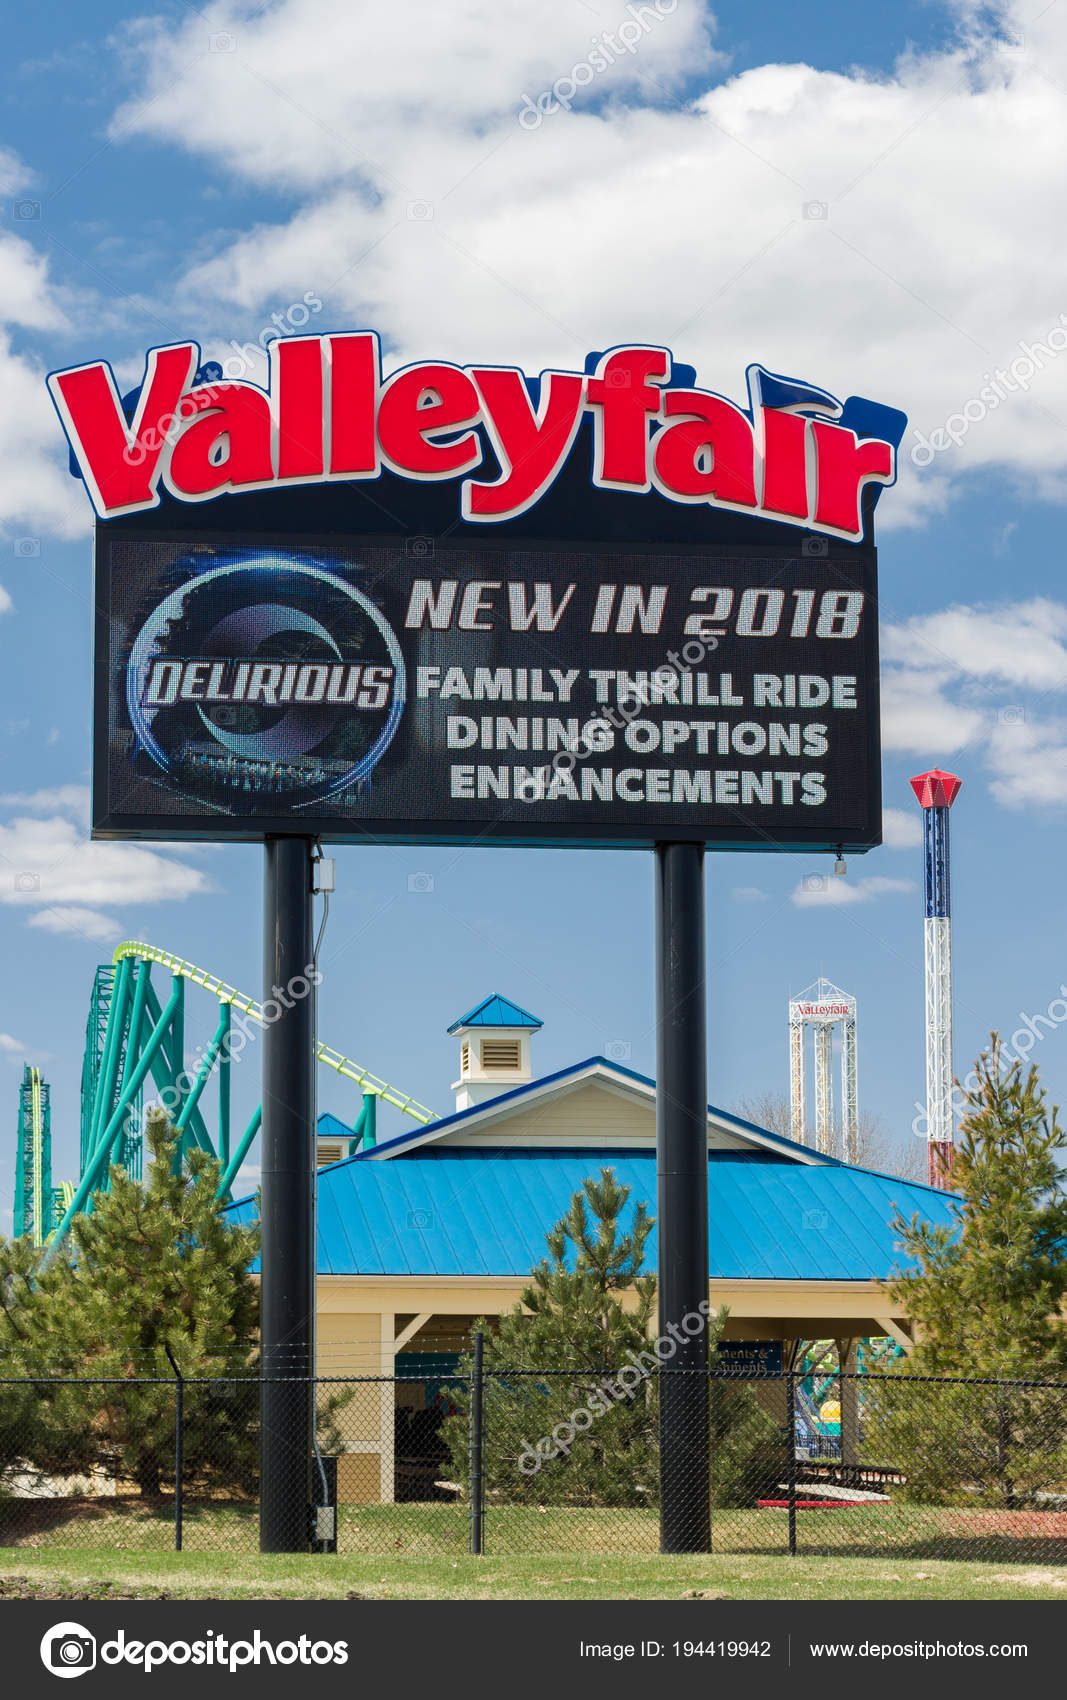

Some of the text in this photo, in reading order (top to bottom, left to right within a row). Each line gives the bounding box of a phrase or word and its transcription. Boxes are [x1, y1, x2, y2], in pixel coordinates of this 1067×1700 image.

[48, 331, 897, 542] Valleyfair
[404, 579, 865, 639] NEW IN 2018
[147, 661, 393, 709] DELIRIOUS
[416, 666, 858, 709] FAMILY THRILL RIDE
[446, 716, 829, 757] DINING OPTIONS
[450, 765, 827, 806] ENHANCEMENTS
